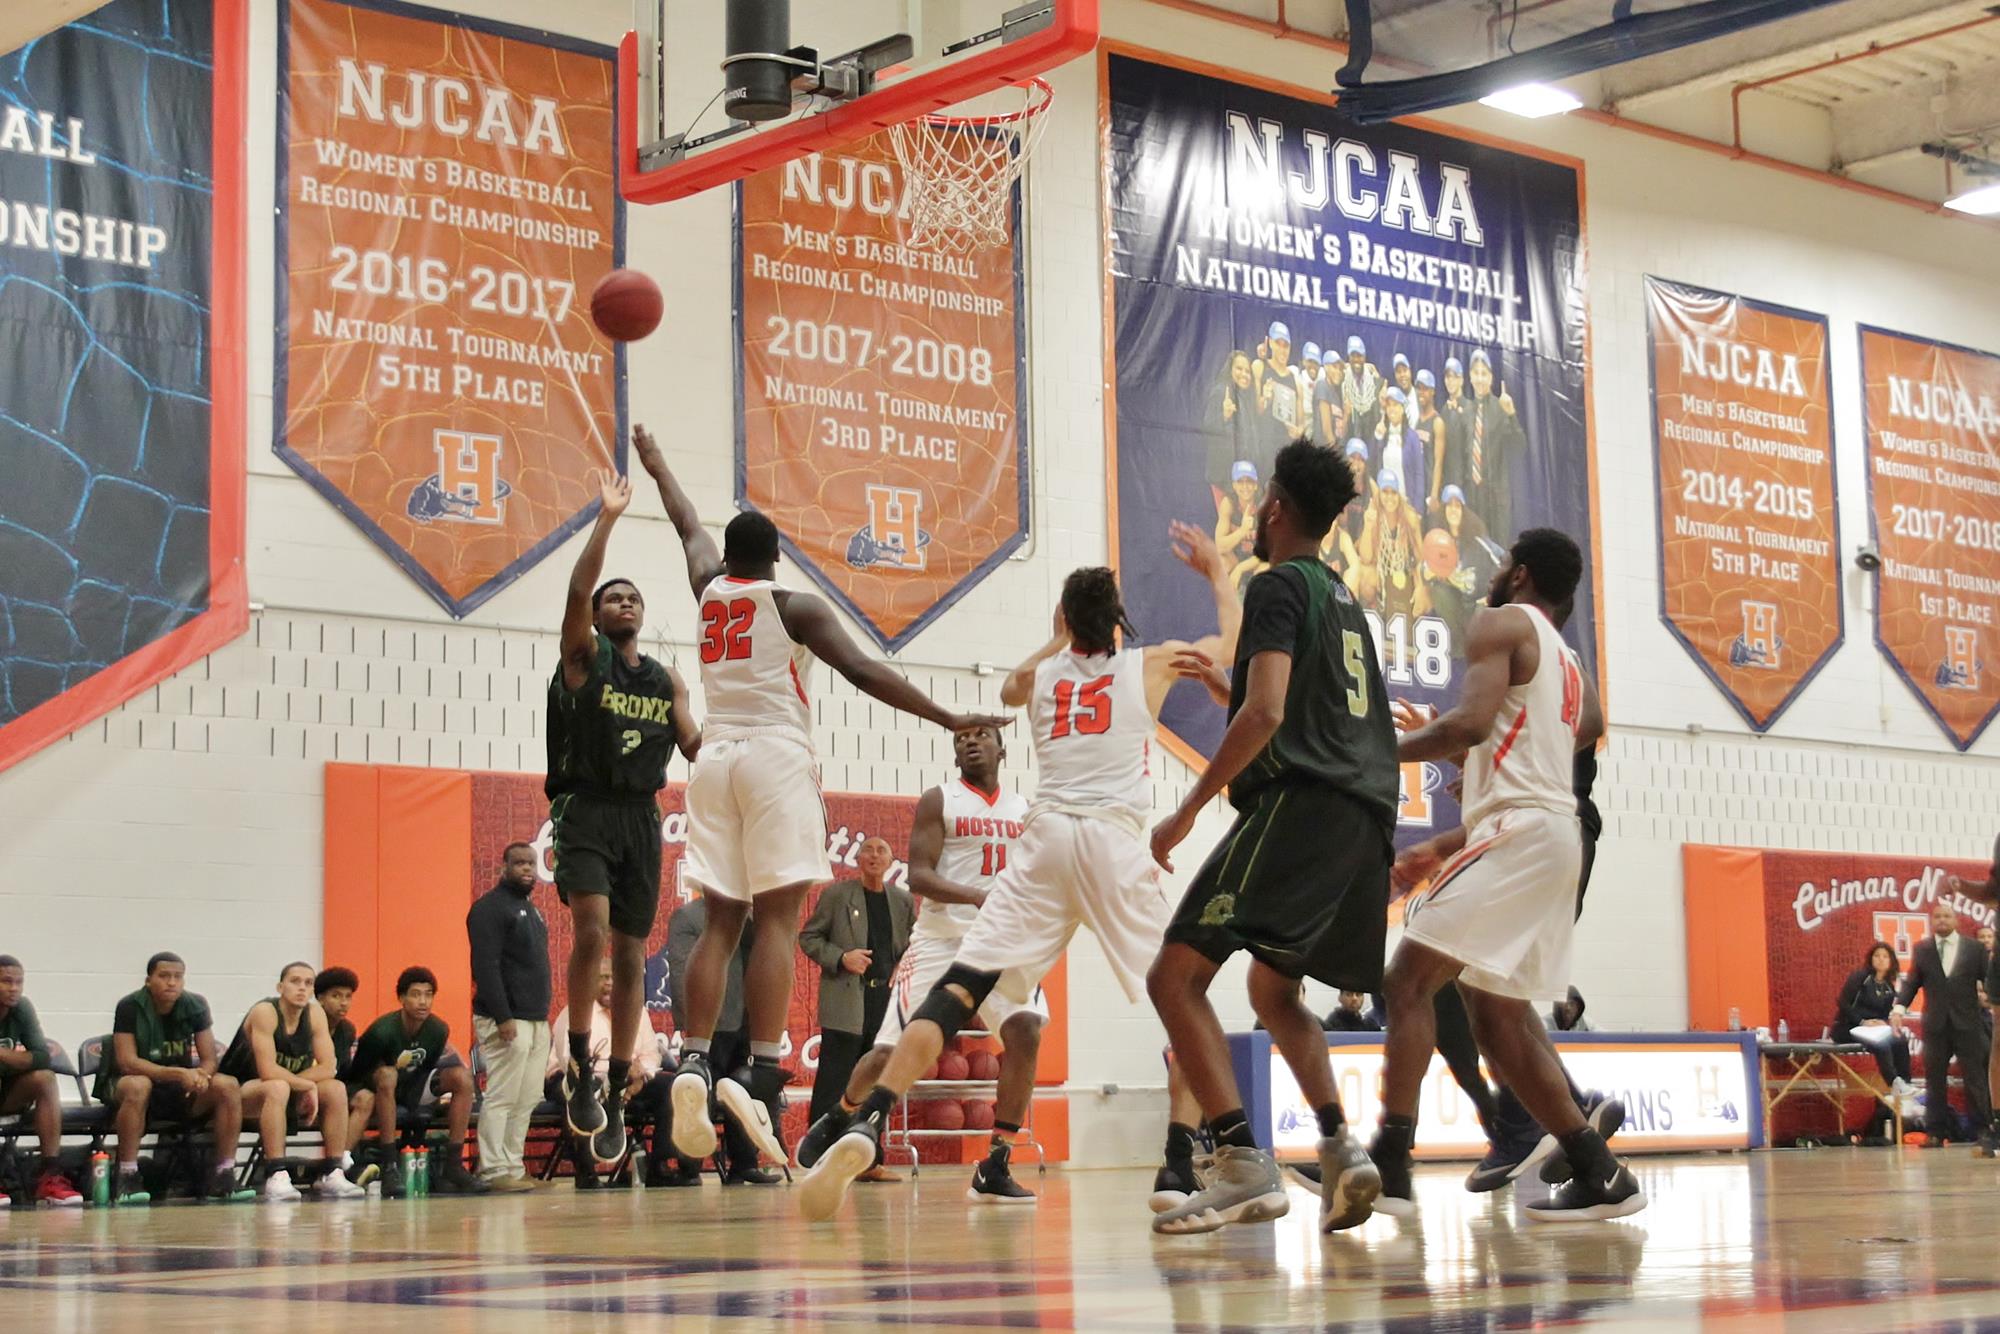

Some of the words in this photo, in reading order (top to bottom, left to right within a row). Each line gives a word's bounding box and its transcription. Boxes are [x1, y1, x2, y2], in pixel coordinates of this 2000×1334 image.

[0, 105, 96, 166] ALL
[337, 57, 569, 157] NJCAA
[314, 137, 438, 183] WOMEN'S
[446, 160, 593, 212] BASKETBALL
[1224, 109, 1485, 248] NJCAA
[300, 176, 422, 221] REGIONAL
[430, 197, 600, 250] CHAMPIONSHIP
[782, 221, 849, 256] MEN'S
[854, 235, 979, 280] BASKETBALL
[1199, 204, 1342, 266] WOMEN'S
[1347, 231, 1522, 304] BASKETBALL
[331, 246, 576, 323] 2016-2017
[752, 253, 854, 293] REGIONAL
[859, 271, 1004, 318] CHAMPIONSHIP
[1175, 242, 1331, 311] NATIONAL
[1336, 275, 1538, 350] CHAMPIONSHIP
[312, 308, 439, 352] NATIONAL
[446, 327, 603, 376] TOURNAMENT
[767, 316, 994, 386] 2007-2008
[1679, 332, 1805, 397] NJCAA
[377, 354, 441, 394] 5TH
[452, 364, 545, 408] PLACE
[764, 374, 869, 413] NATIONAL
[875, 391, 1008, 432] TOURNAMENT
[1888, 374, 1998, 435] NJCAA
[820, 416, 871, 450] 3RD
[880, 425, 958, 464] PLACE
[1663, 418, 1730, 448] REGIONAL
[1732, 431, 1824, 465] CHAMPIONSHIP
[1681, 393, 1726, 419] MEN'S
[1728, 402, 1808, 434] BASKETBALL
[1875, 457, 1932, 484] REGIONAL
[1879, 430, 1938, 458] WOMEN'S
[1682, 468, 1814, 521] 2014-2015
[1675, 514, 1743, 544] NATIONAL
[1745, 525, 1830, 557] TOURNAMENT
[1711, 546, 1745, 575] 5TH
[1749, 552, 1800, 582] PLACE
[1884, 557, 1943, 586] NATIONAL
[699, 597, 756, 665] 32
[1919, 591, 1944, 618] 1ST
[1947, 596, 1992, 624] PLACE
[1341, 627, 1369, 719] 5
[600, 683, 672, 725] BRONX
[1050, 673, 1115, 740] 15
[980, 841, 1007, 877] 11
[1792, 876, 1898, 931] Caiman
